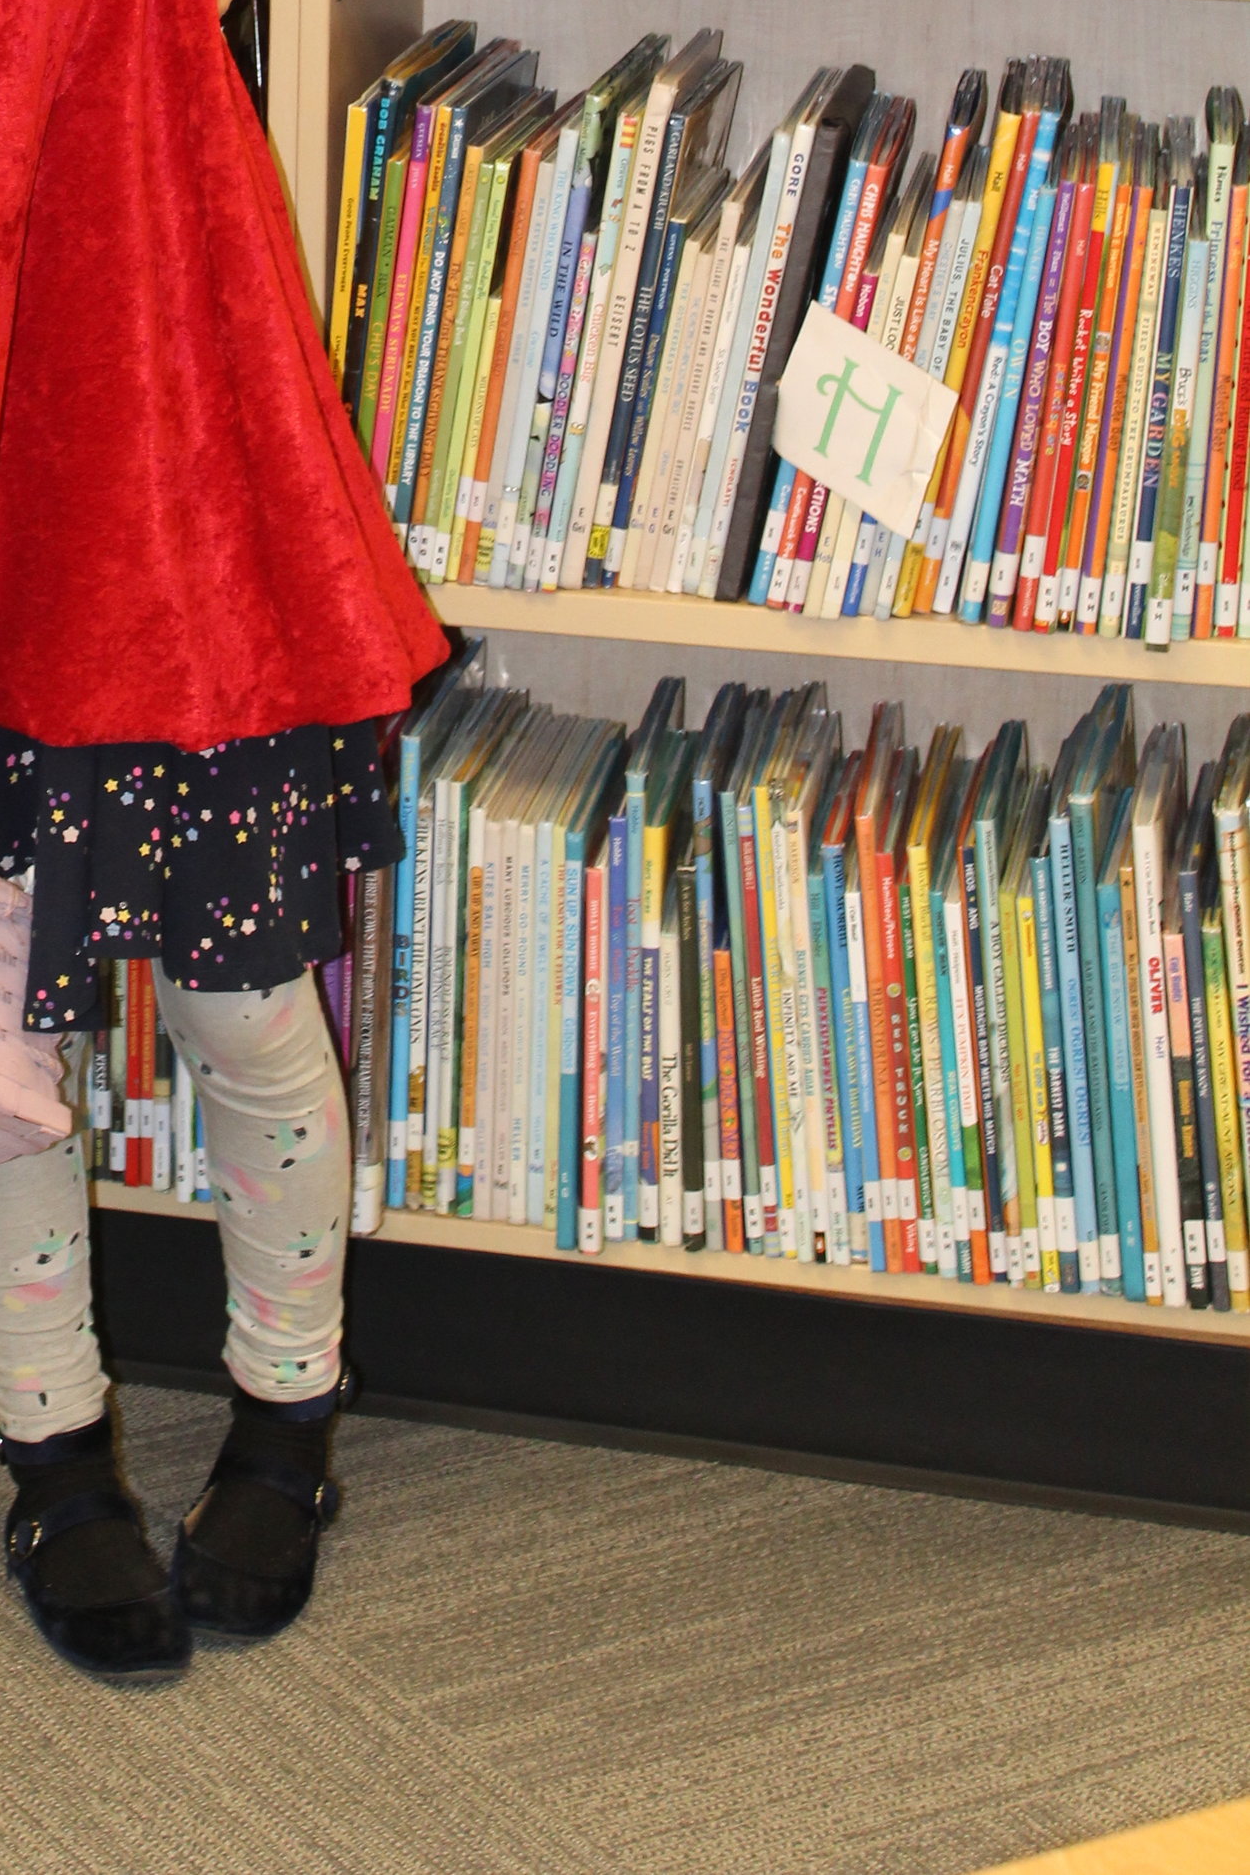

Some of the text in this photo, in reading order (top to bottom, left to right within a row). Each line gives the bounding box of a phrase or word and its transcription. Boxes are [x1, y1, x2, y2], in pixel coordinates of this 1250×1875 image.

[368, 97, 389, 200] BOB GRAHAM
[642, 125, 658, 154] PIGS
[1014, 152, 1027, 172] Hall
[634, 163, 650, 195] FROM
[785, 151, 805, 197] GORE
[941, 163, 954, 184] Hall
[989, 170, 1003, 192] Hall
[1092, 188, 1109, 221] Hills
[538, 169, 567, 290] THE KING WHO RAINED
[627, 221, 639, 236] TO
[830, 177, 861, 269] CHRIS HAUGHTON
[841, 182, 880, 292] CHRIS HAUGHTON
[1166, 203, 1187, 278] HENKES
[546, 240, 574, 338] IN THE WILD
[979, 263, 1003, 319] Cat Tale
[1145, 227, 1161, 297] HEMINGWAY
[354, 283, 367, 317] MAX
[605, 295, 626, 348] GEISERT
[734, 220, 792, 434] The Wonderful Book
[931, 237, 970, 372] JULIUS, THE BABY OF
[953, 247, 989, 350] Frankencrayon
[1073, 307, 1093, 351] Rocket
[363, 321, 385, 400] CHU'S DAY
[379, 274, 407, 414] ELENA'S SERENADE
[400, 250, 445, 485] DO NOT BRING YOUR DRAGON TO THE LIBRARY
[578, 302, 605, 384] Chicken Big
[619, 285, 652, 402] THE LOTUS SEED
[1003, 337, 1027, 400] OWEN
[1066, 356, 1084, 396] Writes
[539, 372, 571, 497] DOODLER DOODLING
[812, 355, 904, 487] H
[967, 355, 1003, 467] Red: A Crayon's Story
[1060, 411, 1077, 446] Story
[1078, 359, 1105, 464] My Friend Maggie
[1142, 351, 1171, 488] MY GARDEN
[566, 868, 577, 895] SUN
[964, 864, 978, 929] HEOS ANG
[1059, 844, 1075, 952] HELLER SMITH
[409, 817, 430, 1044] CHICKENS AREN'T THE ONLY ONES
[565, 923, 577, 950] SUN
[881, 876, 895, 959] Hamilton/Petrone
[990, 932, 1001, 960] BOY
[501, 942, 510, 995] LOLLIPOPS
[564, 955, 576, 997] DOWN
[993, 966, 1005, 1019] CALLED
[1147, 956, 1162, 1014] OLIVER
[750, 976, 766, 1077] Little Red Writing
[783, 992, 794, 1045] INFINITY
[974, 984, 996, 1154] MUSTACHE BABY MEETS HIS MATCH
[997, 1023, 1010, 1083] DICKENS
[661, 1052, 678, 1177] The Gorilla Did It
[788, 1081, 797, 1097] ME
[1048, 1047, 1064, 1136] THE DARKEST DARK
[904, 1223, 917, 1253] Viking
